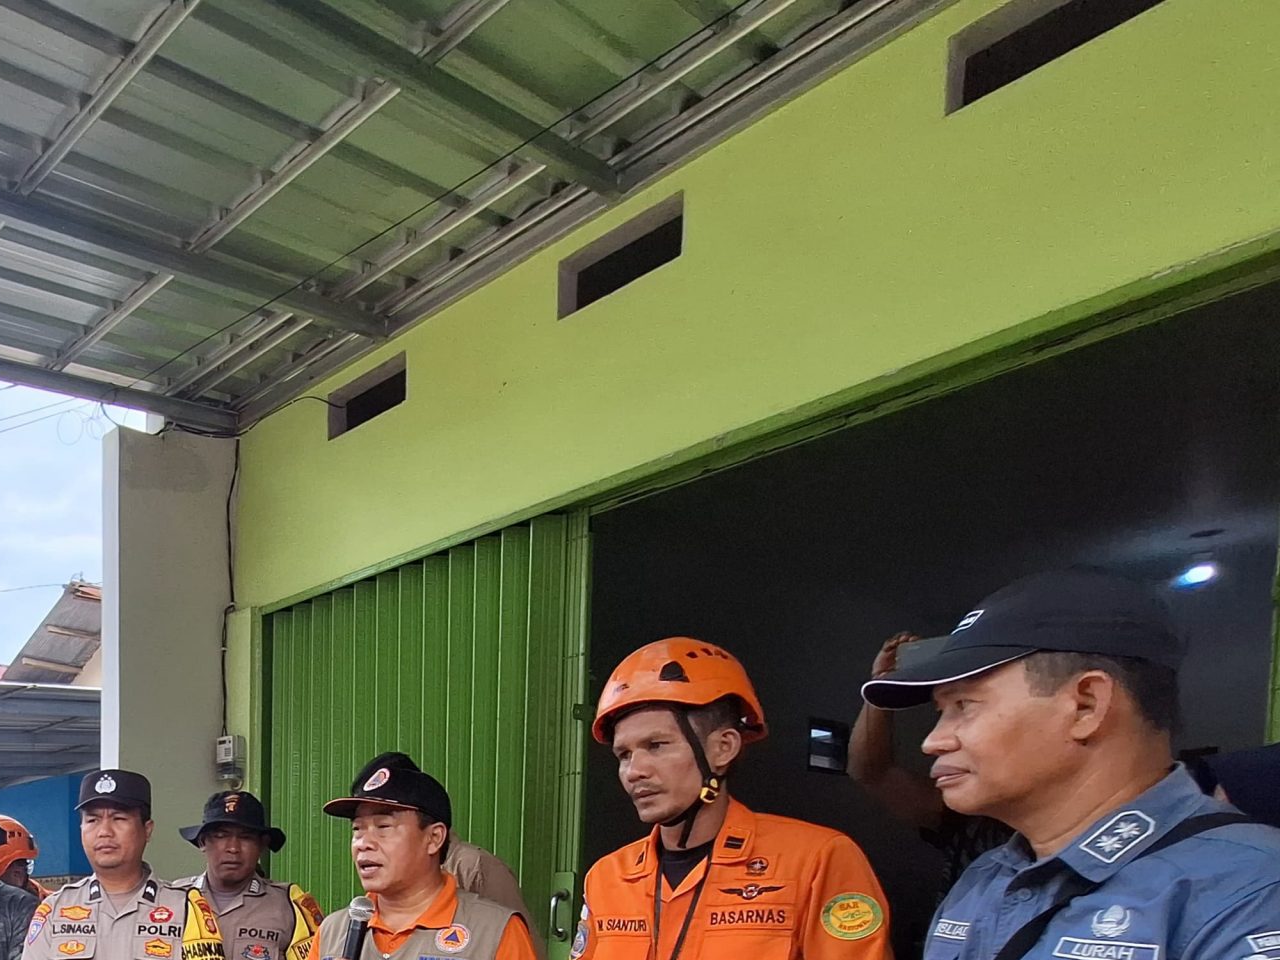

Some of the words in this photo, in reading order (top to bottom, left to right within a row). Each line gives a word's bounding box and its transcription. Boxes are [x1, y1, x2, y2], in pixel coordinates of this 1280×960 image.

[710, 909, 786, 926] BASARNAS
[138, 925, 181, 937] POLRI
[239, 928, 279, 942] POLRI
[1071, 943, 1134, 960] LURAH
